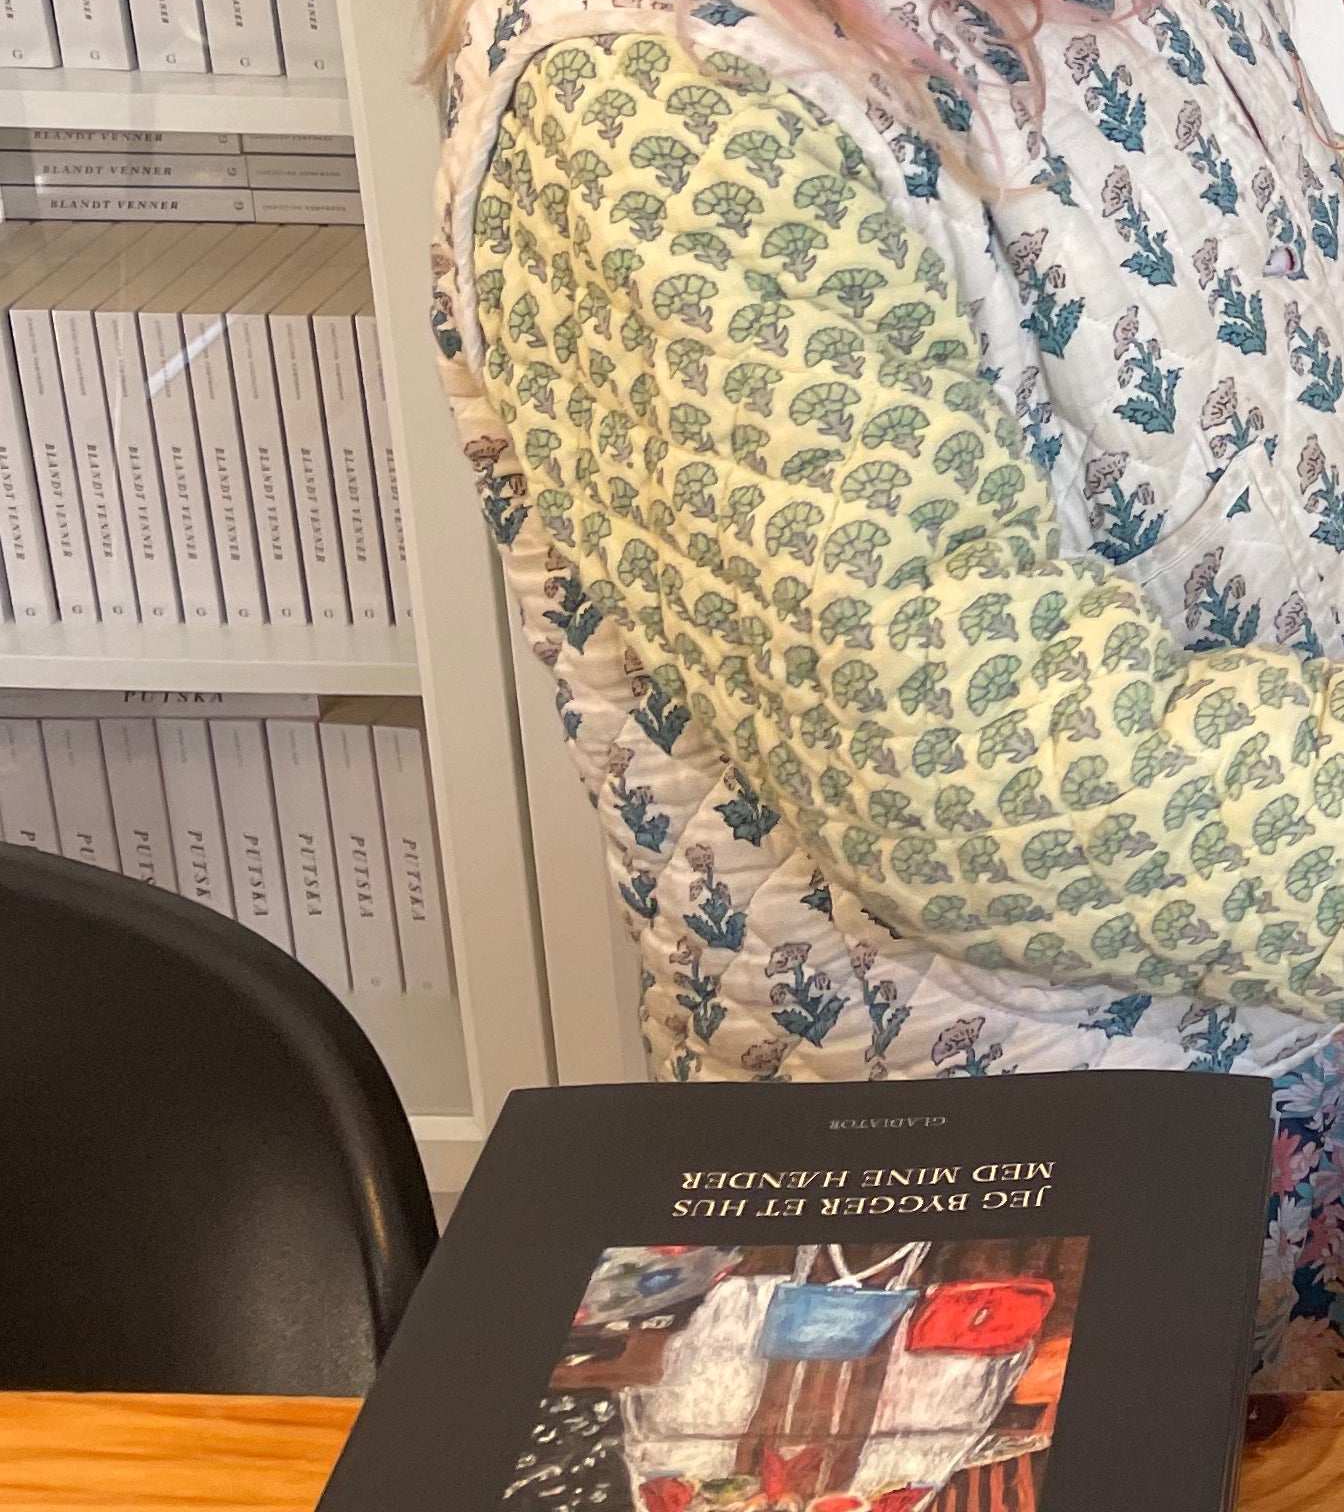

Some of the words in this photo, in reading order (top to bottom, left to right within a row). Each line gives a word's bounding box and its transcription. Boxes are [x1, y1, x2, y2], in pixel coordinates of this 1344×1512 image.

[43, 166, 104, 175] BLANDT
[110, 166, 172, 176] VENNER
[50, 199, 111, 209] BLANDT
[117, 200, 179, 210] VENNER
[258, 447, 275, 502] BLANDT
[267, 506, 283, 561] VENNER
[187, 830, 212, 898] PUTSK
[243, 832, 268, 916] PUTSKA
[298, 834, 322, 916] PUTSKA
[350, 834, 374, 918] PUTSKA
[402, 837, 426, 921] PUTSKA
[828, 1116, 947, 1130] GLADIATOR
[681, 1170, 852, 1190] HÆNDER
[862, 1166, 962, 1187] MINE
[971, 1161, 1057, 1183] MED
[671, 1199, 749, 1218] HUS
[756, 1198, 807, 1218] ET
[820, 1191, 971, 1216] BYGGER
[982, 1185, 1052, 1210] JEG
